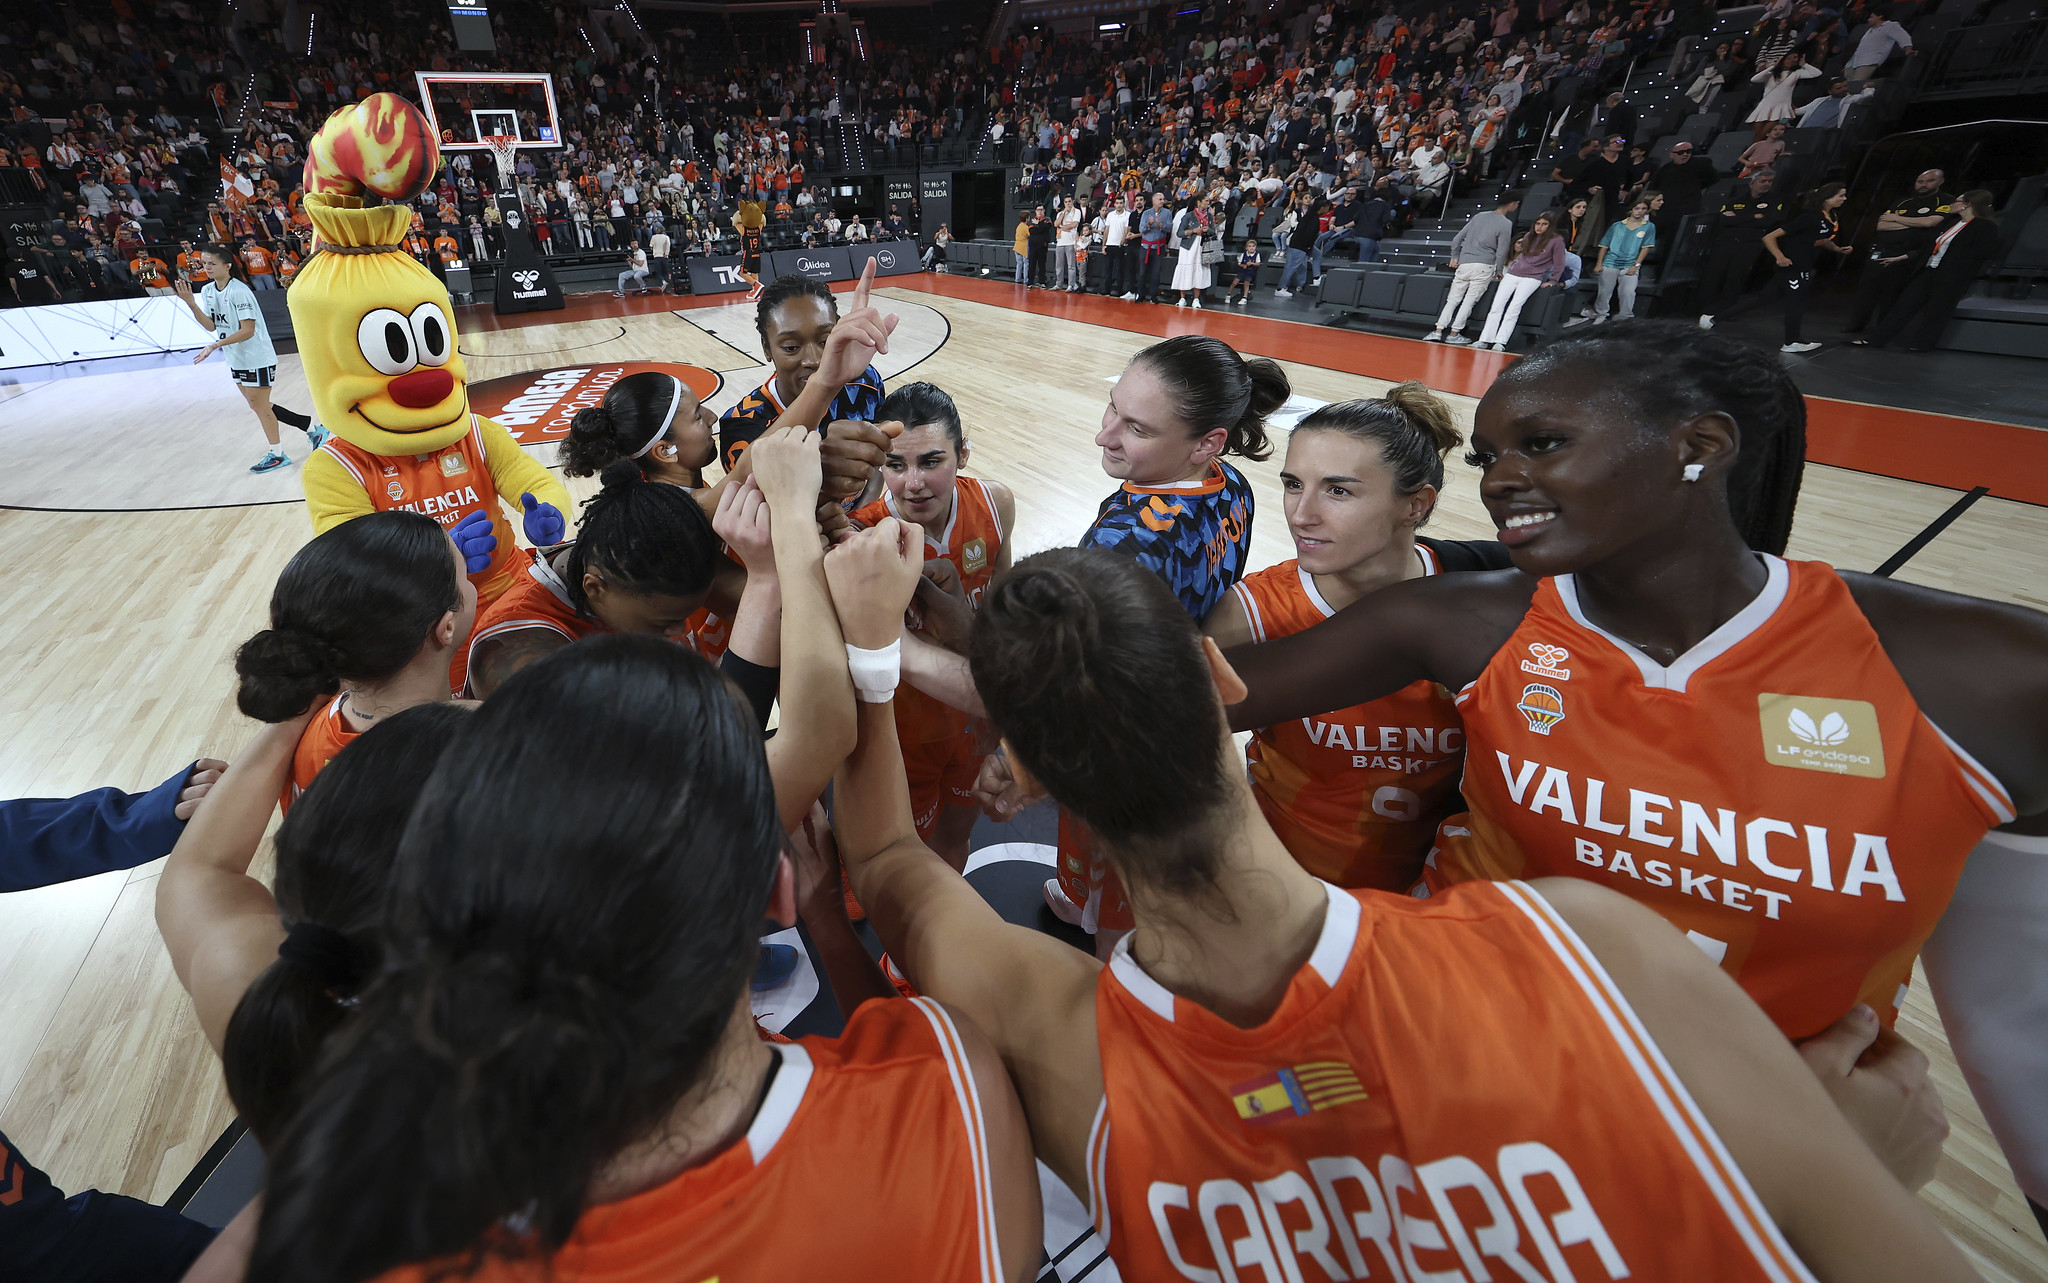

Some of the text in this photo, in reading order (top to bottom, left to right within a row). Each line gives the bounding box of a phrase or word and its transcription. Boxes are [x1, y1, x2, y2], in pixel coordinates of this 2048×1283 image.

[888, 191, 913, 200] SALIDA
[924, 190, 948, 198] SALIDA
[800, 259, 831, 271] Midea
[512, 287, 548, 300] hummel
[388, 485, 480, 516] ALENCIA
[1522, 660, 1568, 679] hummel
[1301, 716, 1462, 755] VALENC
[1777, 744, 1871, 765] LF endesa
[1495, 749, 1907, 903] VALENCIA
[1574, 836, 1793, 921] BASKET
[1147, 1140, 1632, 1283] CARRERA
